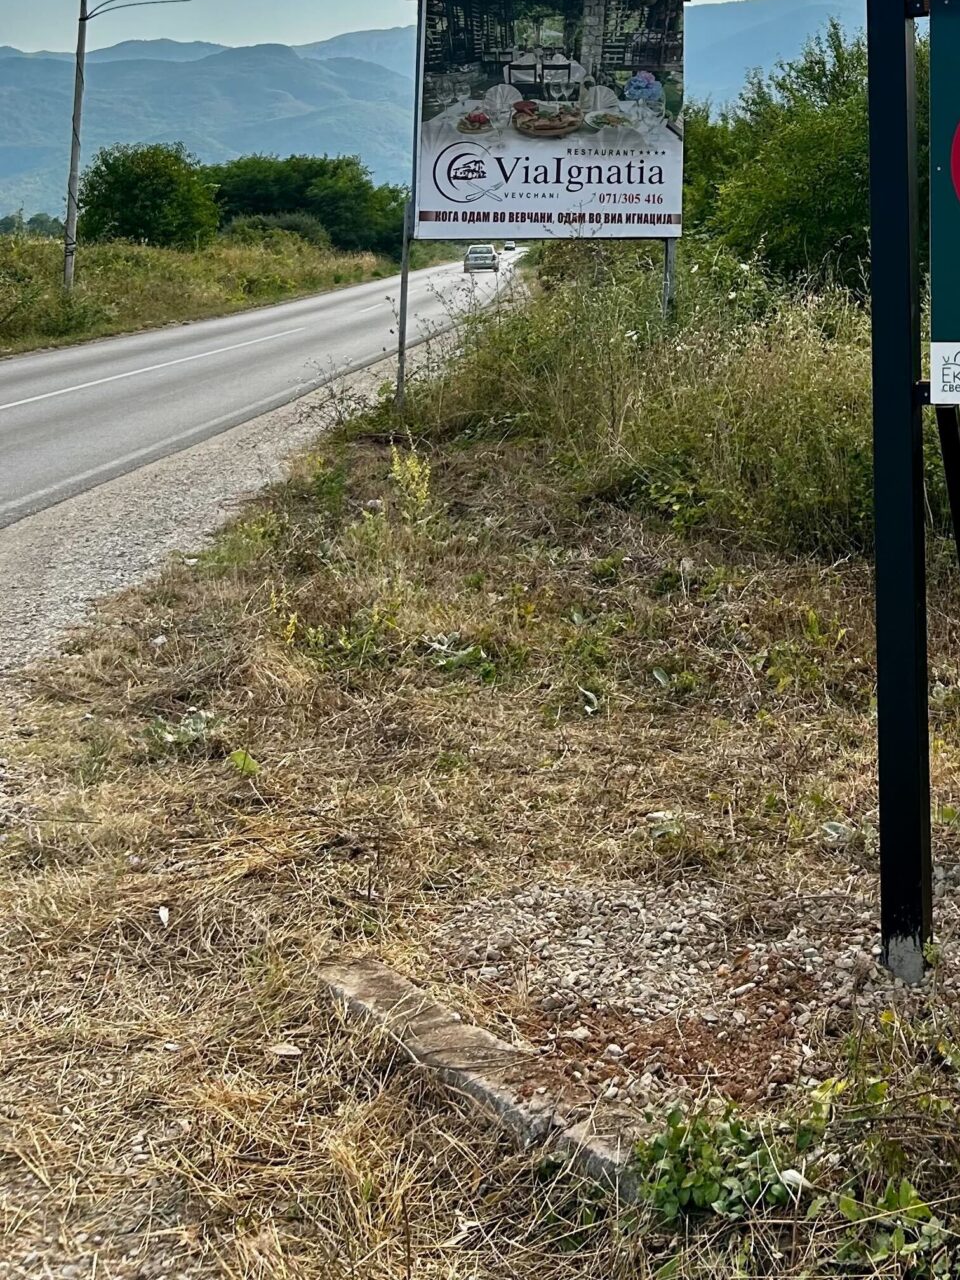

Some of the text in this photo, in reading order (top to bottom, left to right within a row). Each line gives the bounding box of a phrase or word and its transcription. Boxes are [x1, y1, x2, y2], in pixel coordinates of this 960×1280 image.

[567, 148, 635, 156] RESTAURANT
[493, 156, 665, 192] ViaIgnatia
[599, 193, 663, 205] 071/305 416
[435, 211, 459, 223] КОГА
[461, 211, 490, 224] ОДАМ
[493, 211, 506, 223] ВО
[508, 212, 555, 225] ВЕВЧАНИ,
[588, 213, 602, 224] ВО
[604, 213, 623, 224] ВИА
[625, 213, 672, 226] ИГНАЦИЈА
